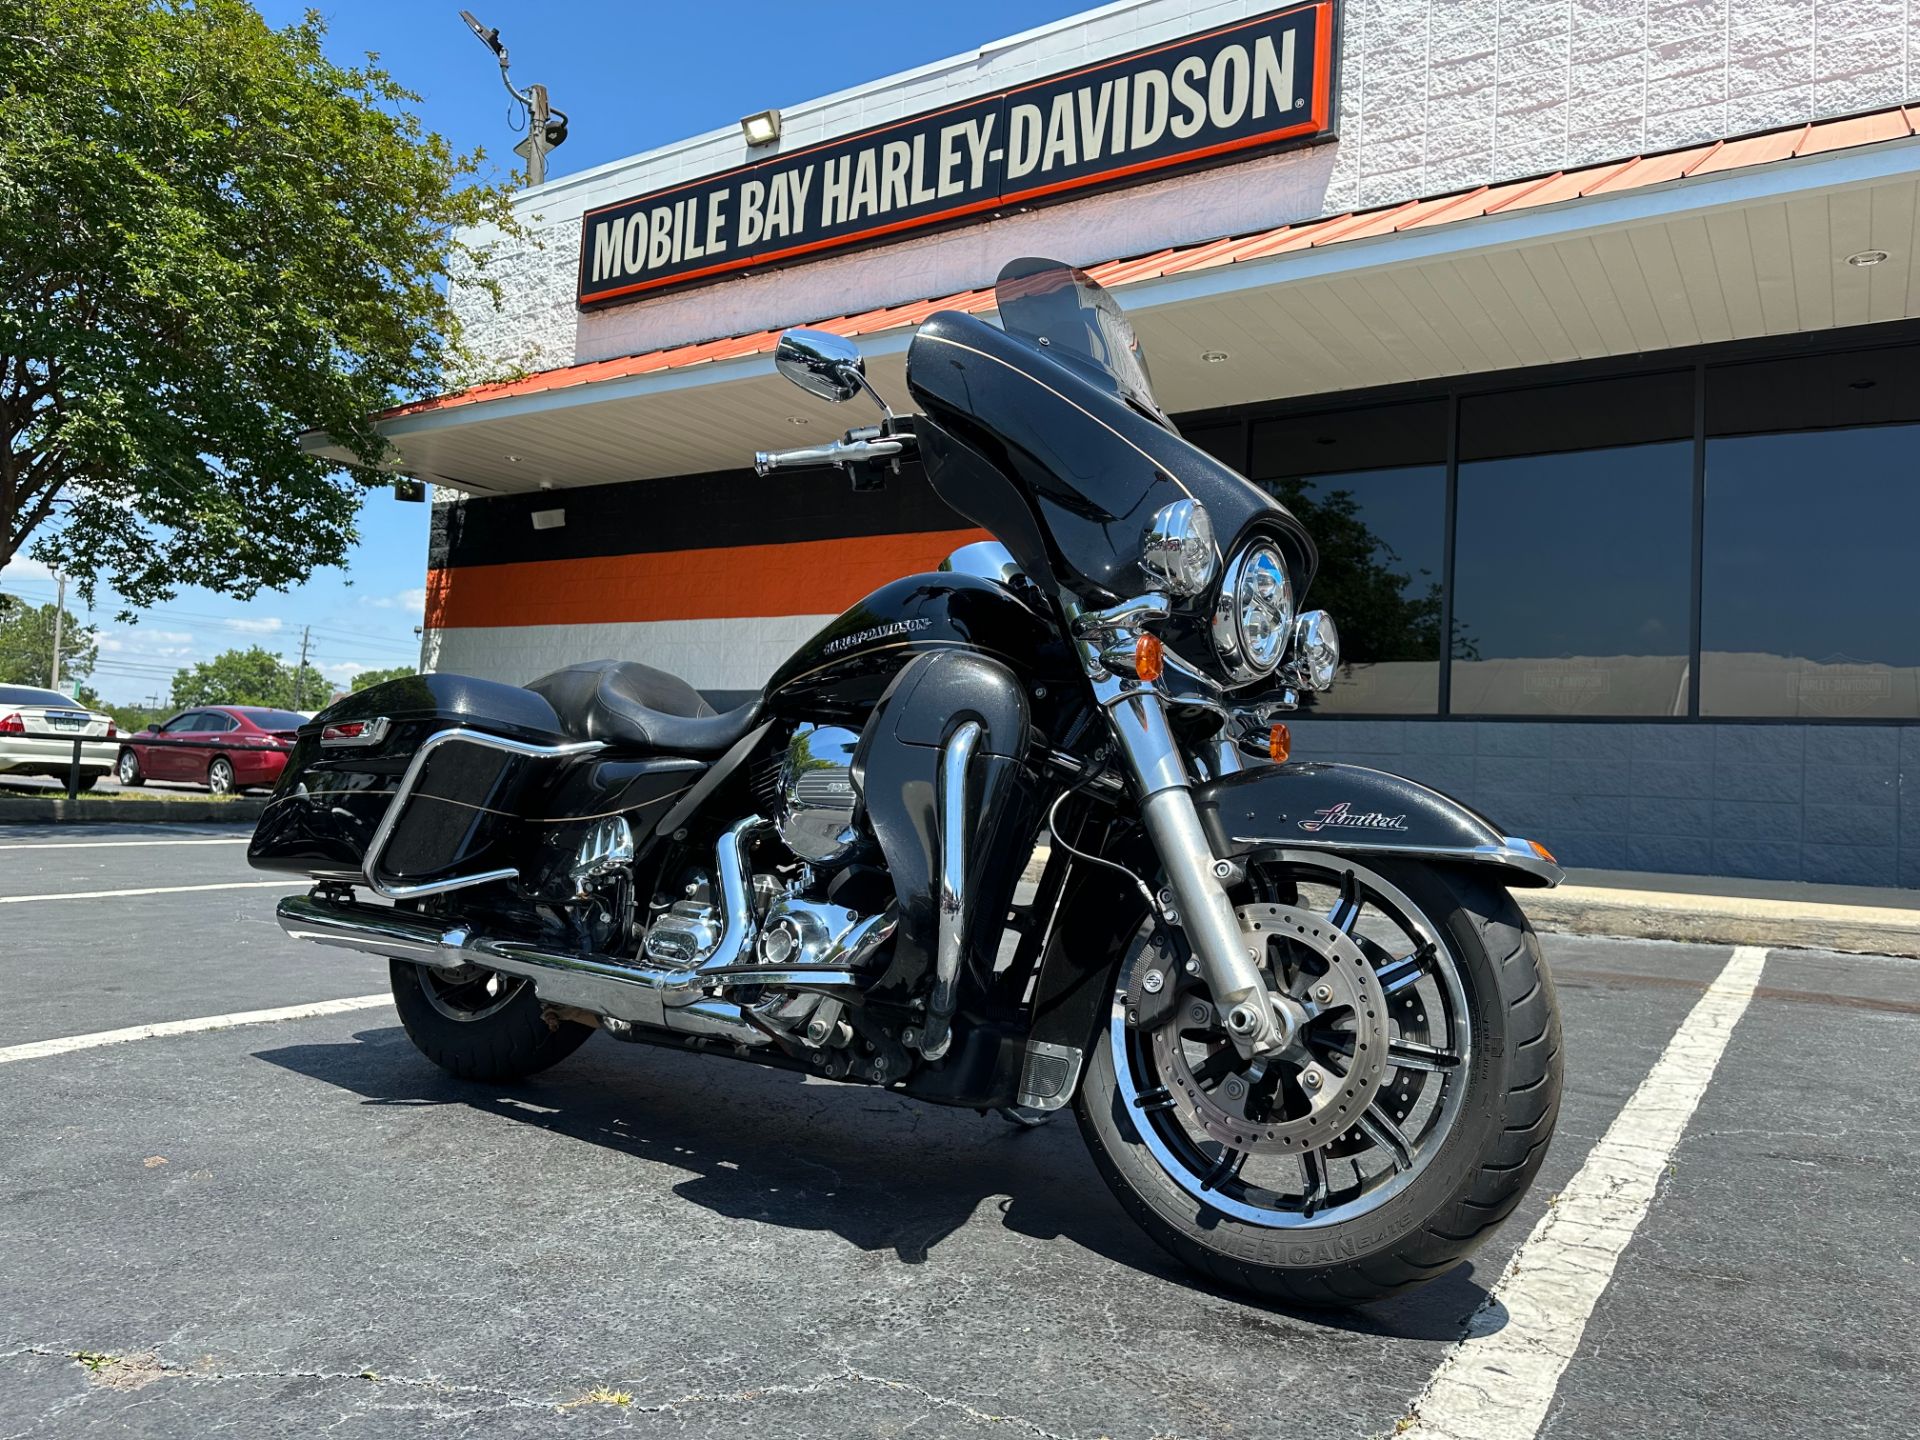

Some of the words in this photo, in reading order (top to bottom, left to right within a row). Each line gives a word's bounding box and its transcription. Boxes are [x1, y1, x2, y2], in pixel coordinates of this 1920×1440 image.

[592, 188, 730, 282] MOBILE
[737, 165, 815, 247] BAY
[1298, 802, 1408, 832] Limited
